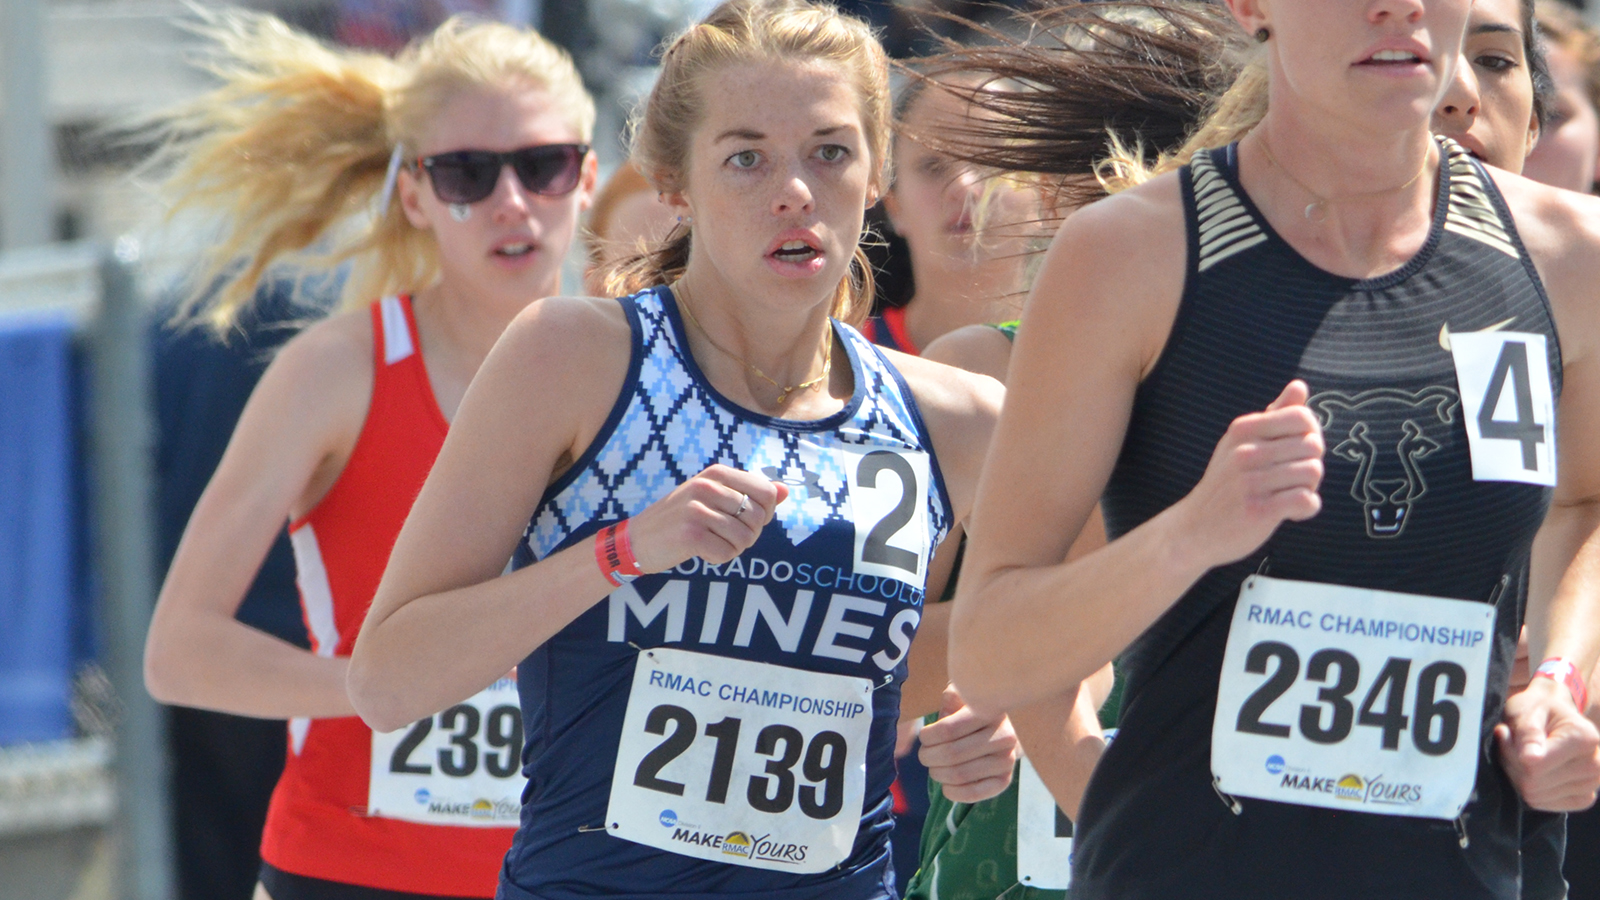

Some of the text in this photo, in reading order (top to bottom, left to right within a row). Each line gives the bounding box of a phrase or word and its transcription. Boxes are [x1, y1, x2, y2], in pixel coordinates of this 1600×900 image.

[1476, 340, 1546, 472] 4
[856, 450, 919, 575] 2
[607, 579, 920, 671] MINES
[1247, 604, 1485, 648] RMAC CHAMPIONSHIP
[649, 669, 865, 720] RMAC CHAMPIONSHIP
[1235, 640, 1467, 757] 2346
[633, 704, 848, 820] 2139
[1280, 773, 1336, 793] MAKE
[1362, 773, 1422, 803] YOURS
[427, 802, 471, 815] MAKE
[672, 828, 808, 861] MAKE RMAC YOURS
